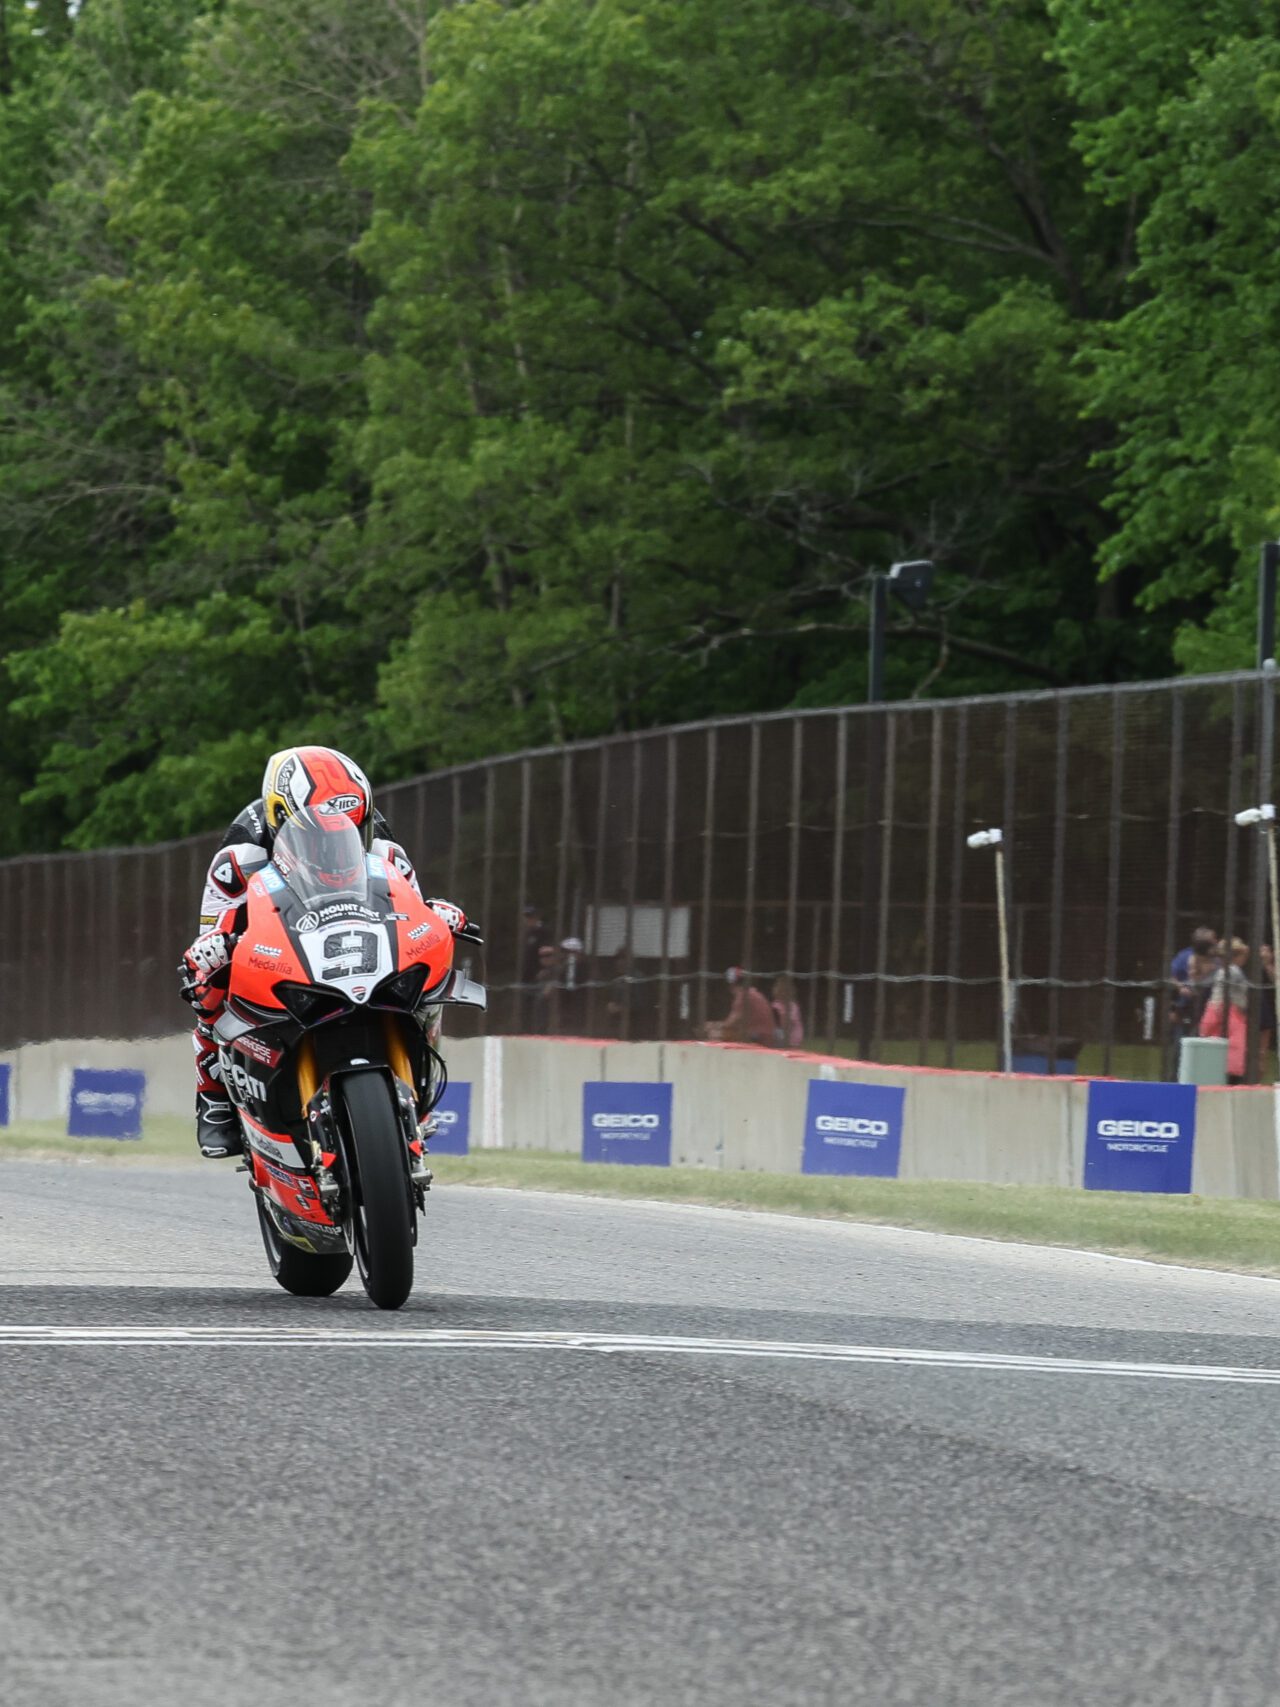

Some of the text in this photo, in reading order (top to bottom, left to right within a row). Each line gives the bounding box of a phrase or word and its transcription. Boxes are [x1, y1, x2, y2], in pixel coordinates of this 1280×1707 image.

[326, 798, 358, 814] X-lite
[320, 903, 359, 917] MOUNT
[321, 929, 380, 981] 9
[248, 957, 293, 975] Medallia
[592, 1113, 660, 1128] GEICO
[815, 1115, 889, 1136] GEICO
[1097, 1119, 1180, 1139] GEICO
[823, 1137, 879, 1149] MOTORCYCLE
[1106, 1142, 1169, 1153] MOTORCYCLE
